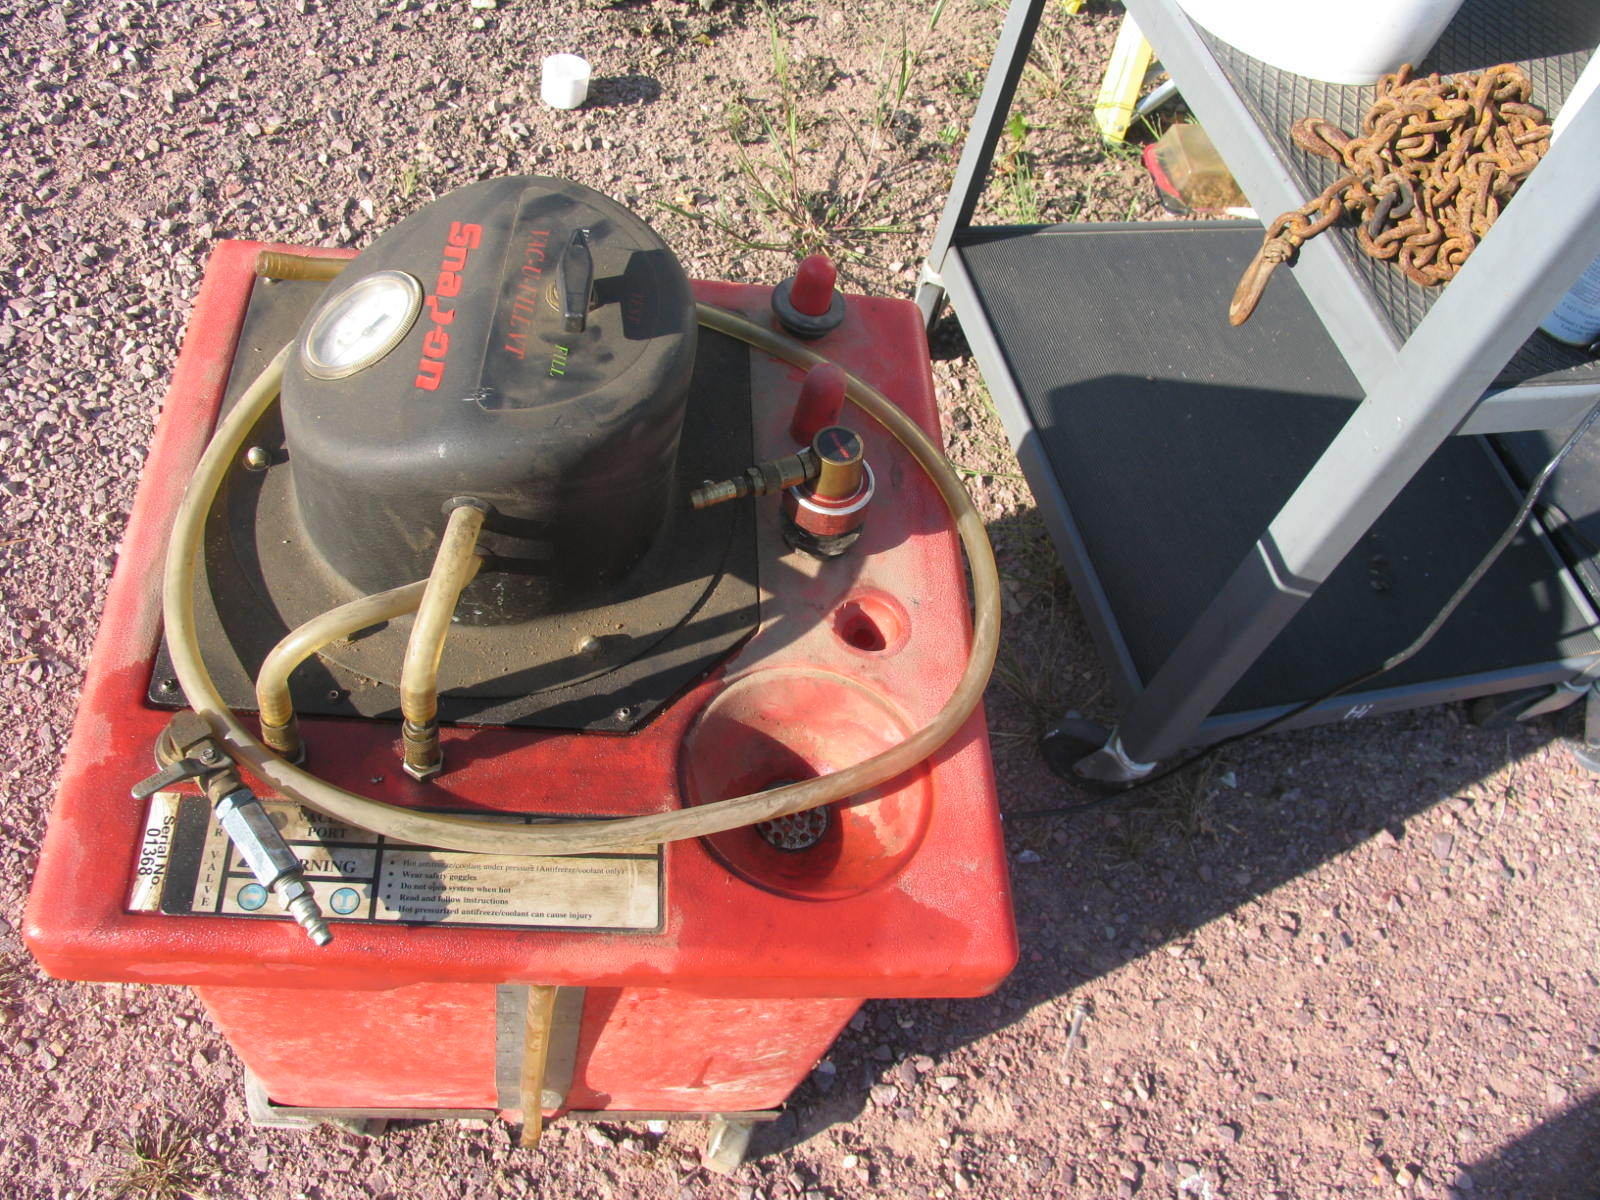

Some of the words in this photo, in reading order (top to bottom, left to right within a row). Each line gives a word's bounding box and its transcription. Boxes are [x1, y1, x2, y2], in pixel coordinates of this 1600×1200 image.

[415, 221, 484, 391] Snap-on
[549, 343, 569, 377] FILL
[156, 815, 176, 859] Serial
[307, 826, 348, 839] PORT
[138, 828, 161, 876] 01368
[299, 858, 357, 874] RNING
[483, 864, 503, 872] under
[149, 863, 167, 889] No.
[201, 850, 221, 907] VALVE
[402, 870, 424, 879] Wear
[425, 871, 446, 881] safety
[449, 873, 478, 882] goggles
[400, 882, 411, 890] Do
[412, 883, 426, 891] not
[428, 884, 447, 892] open
[448, 885, 475, 894] system
[477, 885, 497, 894] when
[399, 893, 420, 902] Read
[421, 894, 436, 902] and
[437, 894, 462, 903] follow
[463, 896, 509, 906] instructions
[398, 904, 413, 914] Hot
[414, 906, 460, 915] pressurized
[461, 907, 529, 918] antifreeze/coolant
[546, 911, 567, 919] cause
[569, 911, 592, 921] injury
